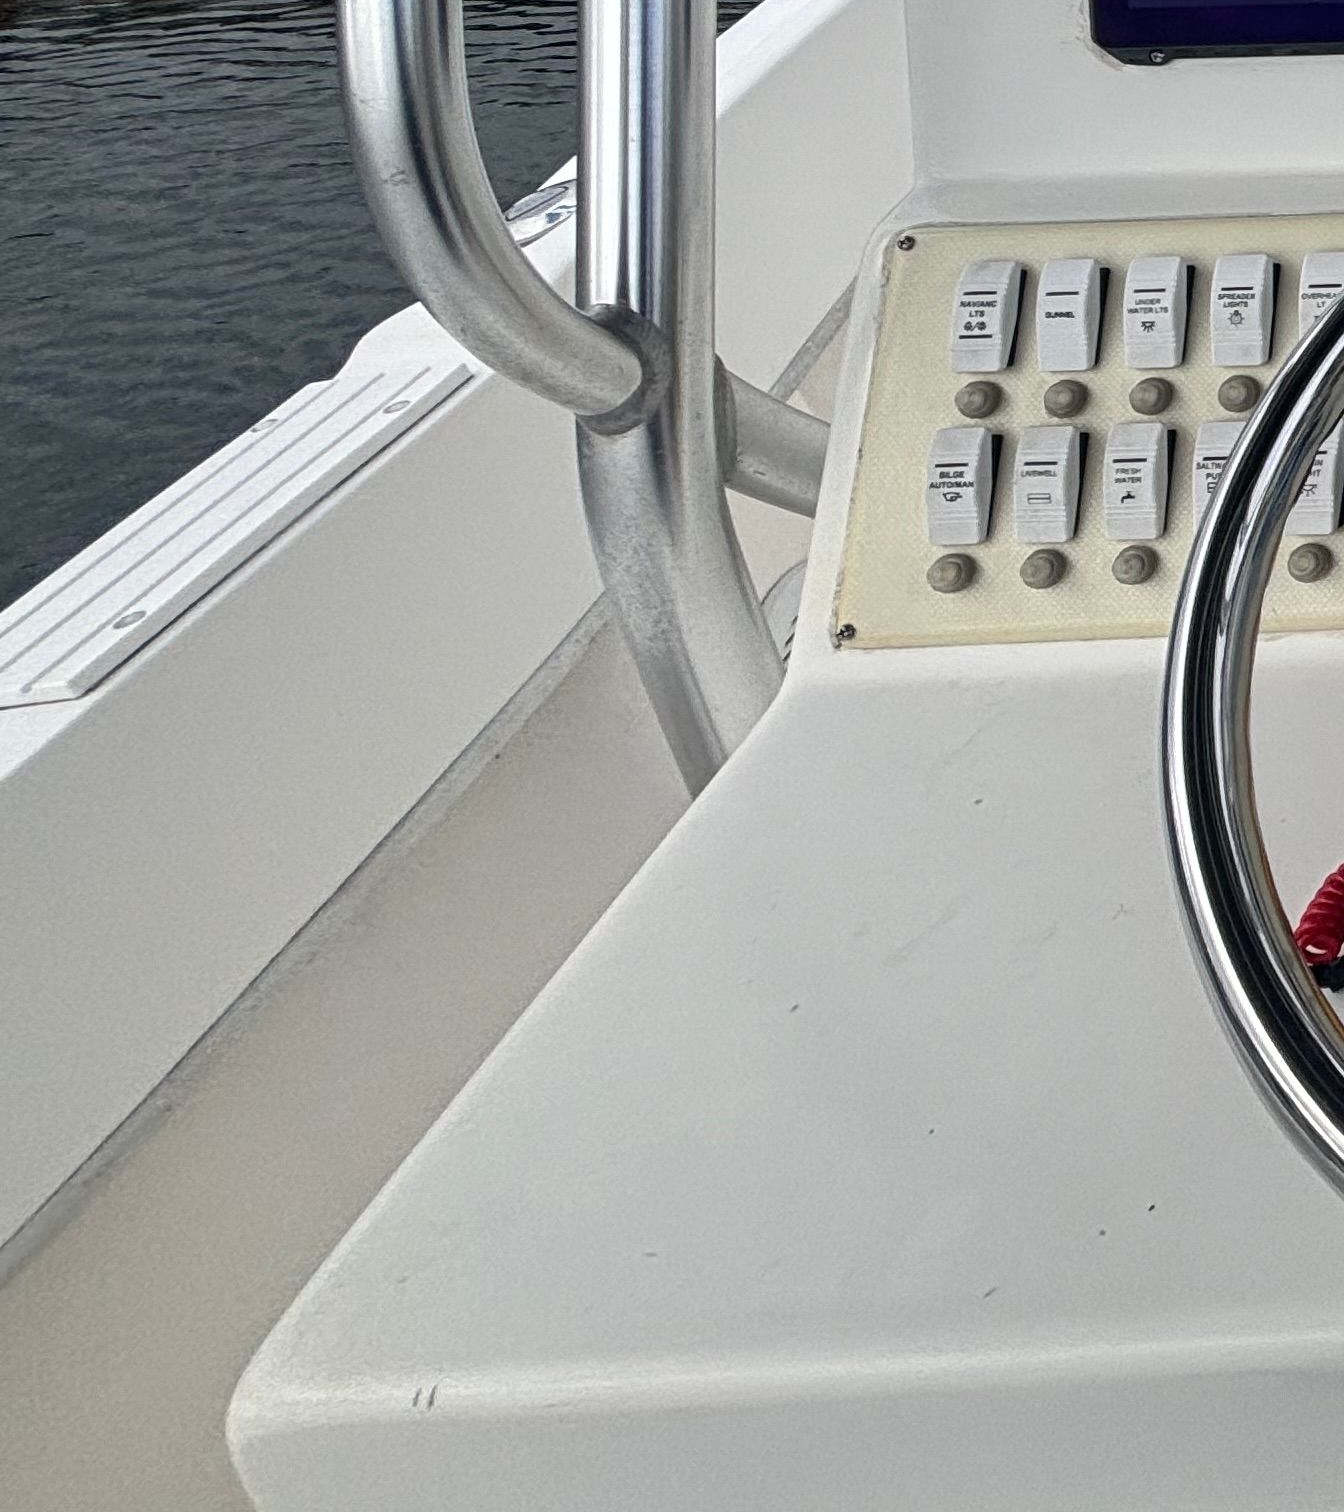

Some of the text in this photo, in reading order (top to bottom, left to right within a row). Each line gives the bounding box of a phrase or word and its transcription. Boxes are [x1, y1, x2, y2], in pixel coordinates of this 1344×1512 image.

[1217, 292, 1256, 300] SPREADER
[1134, 297, 1161, 306] UNDER
[938, 471, 966, 479] BILGE
[1114, 476, 1142, 484] WATER
